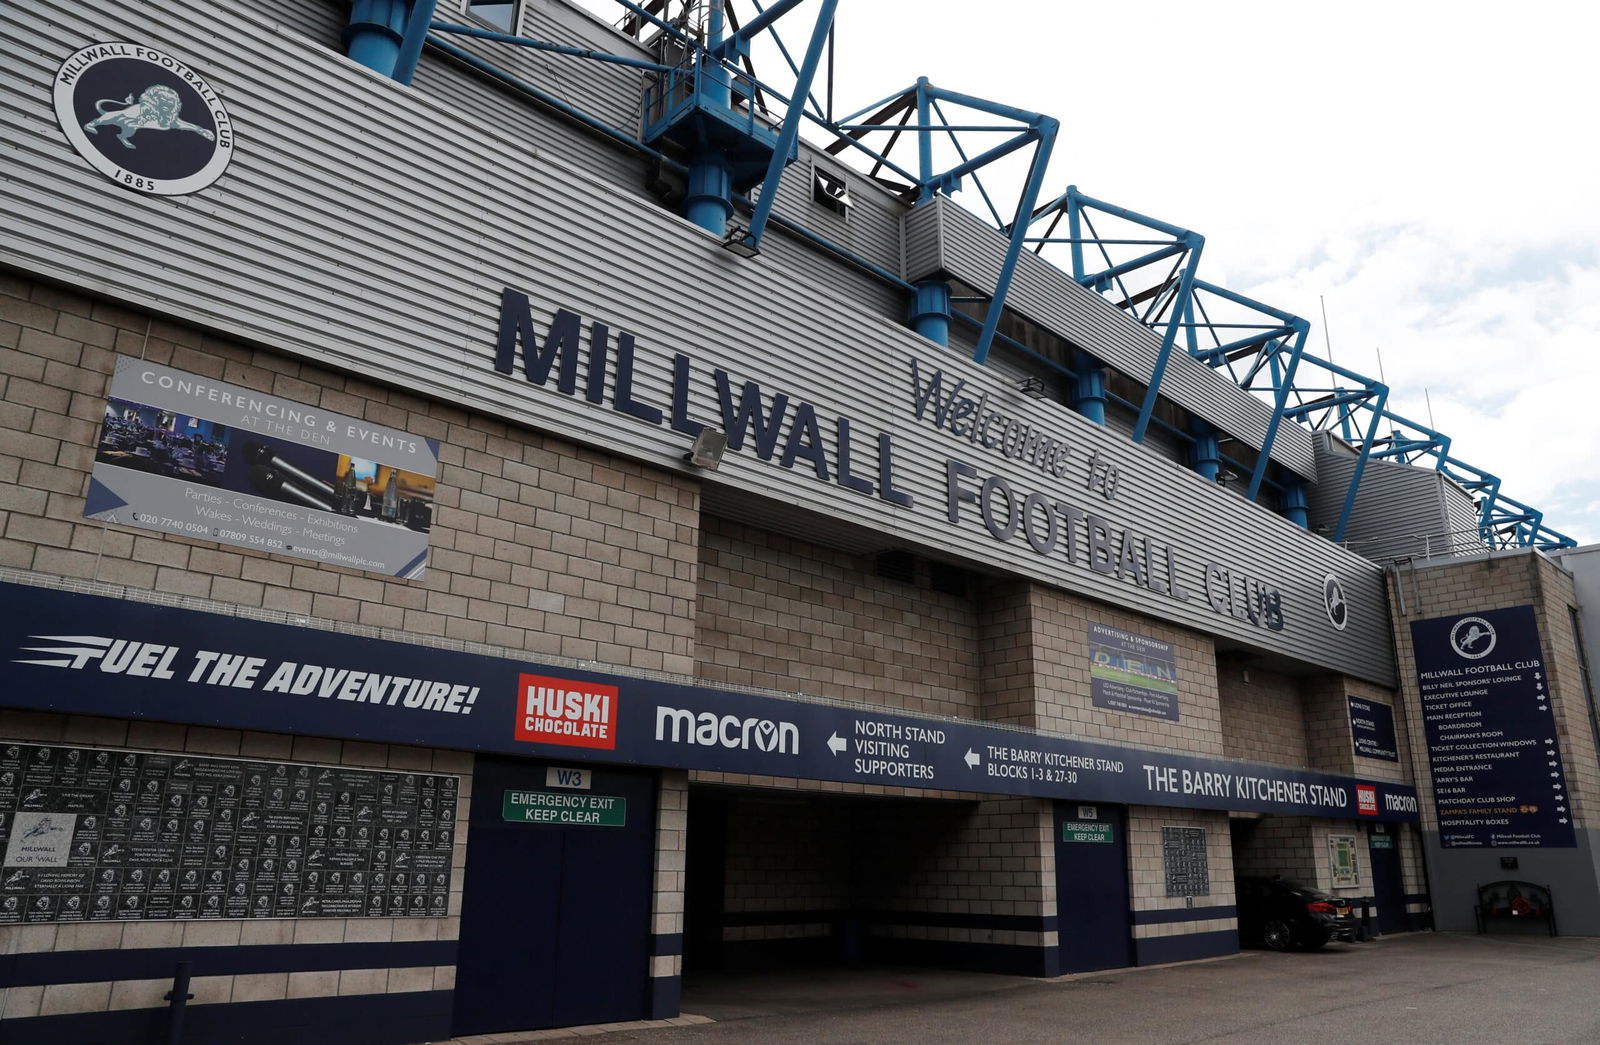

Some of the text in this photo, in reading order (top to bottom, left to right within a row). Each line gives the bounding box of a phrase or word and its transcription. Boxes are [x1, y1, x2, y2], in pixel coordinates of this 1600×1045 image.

[60, 45, 231, 149] MILLWALL FOOTBALL CLUB
[114, 169, 154, 191] 1885
[141, 371, 417, 454] CONFERENCING & EVENTS
[240, 413, 331, 445] AT THE DEN
[910, 358, 1119, 500] Welcome to
[494, 286, 1285, 632] MILLWALL FOOTBALL CLUB
[184, 487, 222, 505] Parties
[233, 498, 298, 521] Conferences
[307, 514, 359, 533] Exhibitions
[195, 505, 232, 522] Wakes
[241, 514, 292, 536] Weddings
[303, 527, 345, 546] Meetings
[139, 513, 385, 569] 020 7740 0504 07809 554 852 events@millwallplc.com
[1093, 625, 1129, 640] ADVERTISING
[1135, 637, 1169, 651] SPONSORSHIP
[10, 635, 480, 715] FUEL THE ADVENTURE!
[1420, 659, 1540, 680] MILLWALL FOOTBALL CLUB
[1422, 683, 1439, 691] BILLY
[1455, 678, 1492, 688] SPONSORS'
[1492, 675, 1522, 684] LOUNGE
[526, 685, 610, 724] HUSKI
[1424, 689, 1489, 701] EXECUTIVE LOUNGE
[1425, 701, 1472, 711] TICKET OFFICE
[1444, 711, 1482, 720] RECEPTION
[525, 716, 608, 739] CHOCOLATE
[655, 705, 799, 755] macron
[854, 719, 946, 745] NORTH STAND
[1438, 722, 1482, 731] BOARDROOM
[1439, 732, 1481, 741] CHAIRMAN'S
[854, 739, 910, 759] VISITING
[1455, 742, 1499, 751] COLLECTION
[1499, 739, 1537, 748] WINDOWS
[986, 745, 1124, 774] THE BARRY KITCHENER STAND
[1432, 751, 1520, 762] KITCHENER'S RESTAURANT
[557, 770, 582, 787] W3
[854, 758, 935, 780] SUPPORTERS
[987, 761, 1078, 784] BLOCKS 1-3 & 27-30
[1456, 764, 1493, 772] ENTRANCE
[1143, 764, 1348, 808] THE BARRY KITCHENER STAND
[1358, 789, 1376, 804] HUSKI
[511, 793, 615, 810] EMERGENCY EXIT
[1384, 793, 1418, 813] macron
[525, 808, 600, 823] KEEP CLEAR
[1082, 807, 1094, 818] W5
[1067, 823, 1110, 832] EMERGENCY EXIT
[1074, 833, 1105, 841] KEEP CLEAR
